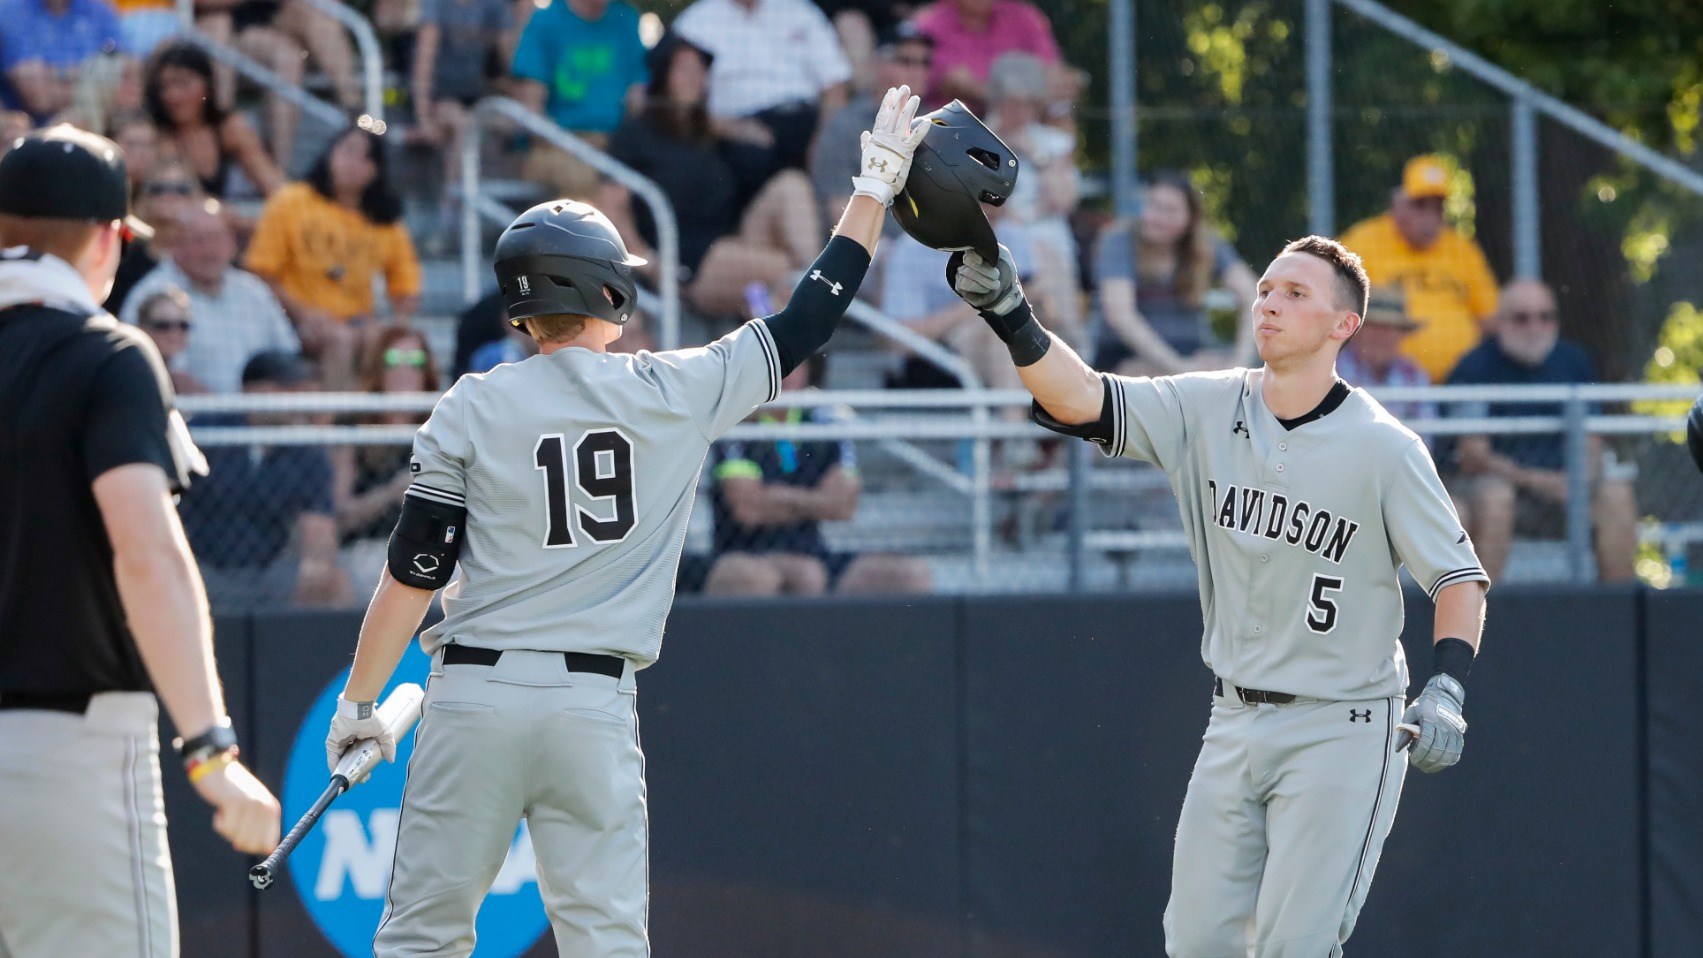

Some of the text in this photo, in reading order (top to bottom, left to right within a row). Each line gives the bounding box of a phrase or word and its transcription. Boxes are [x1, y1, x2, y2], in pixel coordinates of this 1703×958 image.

[517, 275, 529, 290] 19
[533, 427, 639, 549] 19
[1304, 572, 1345, 635] 5
